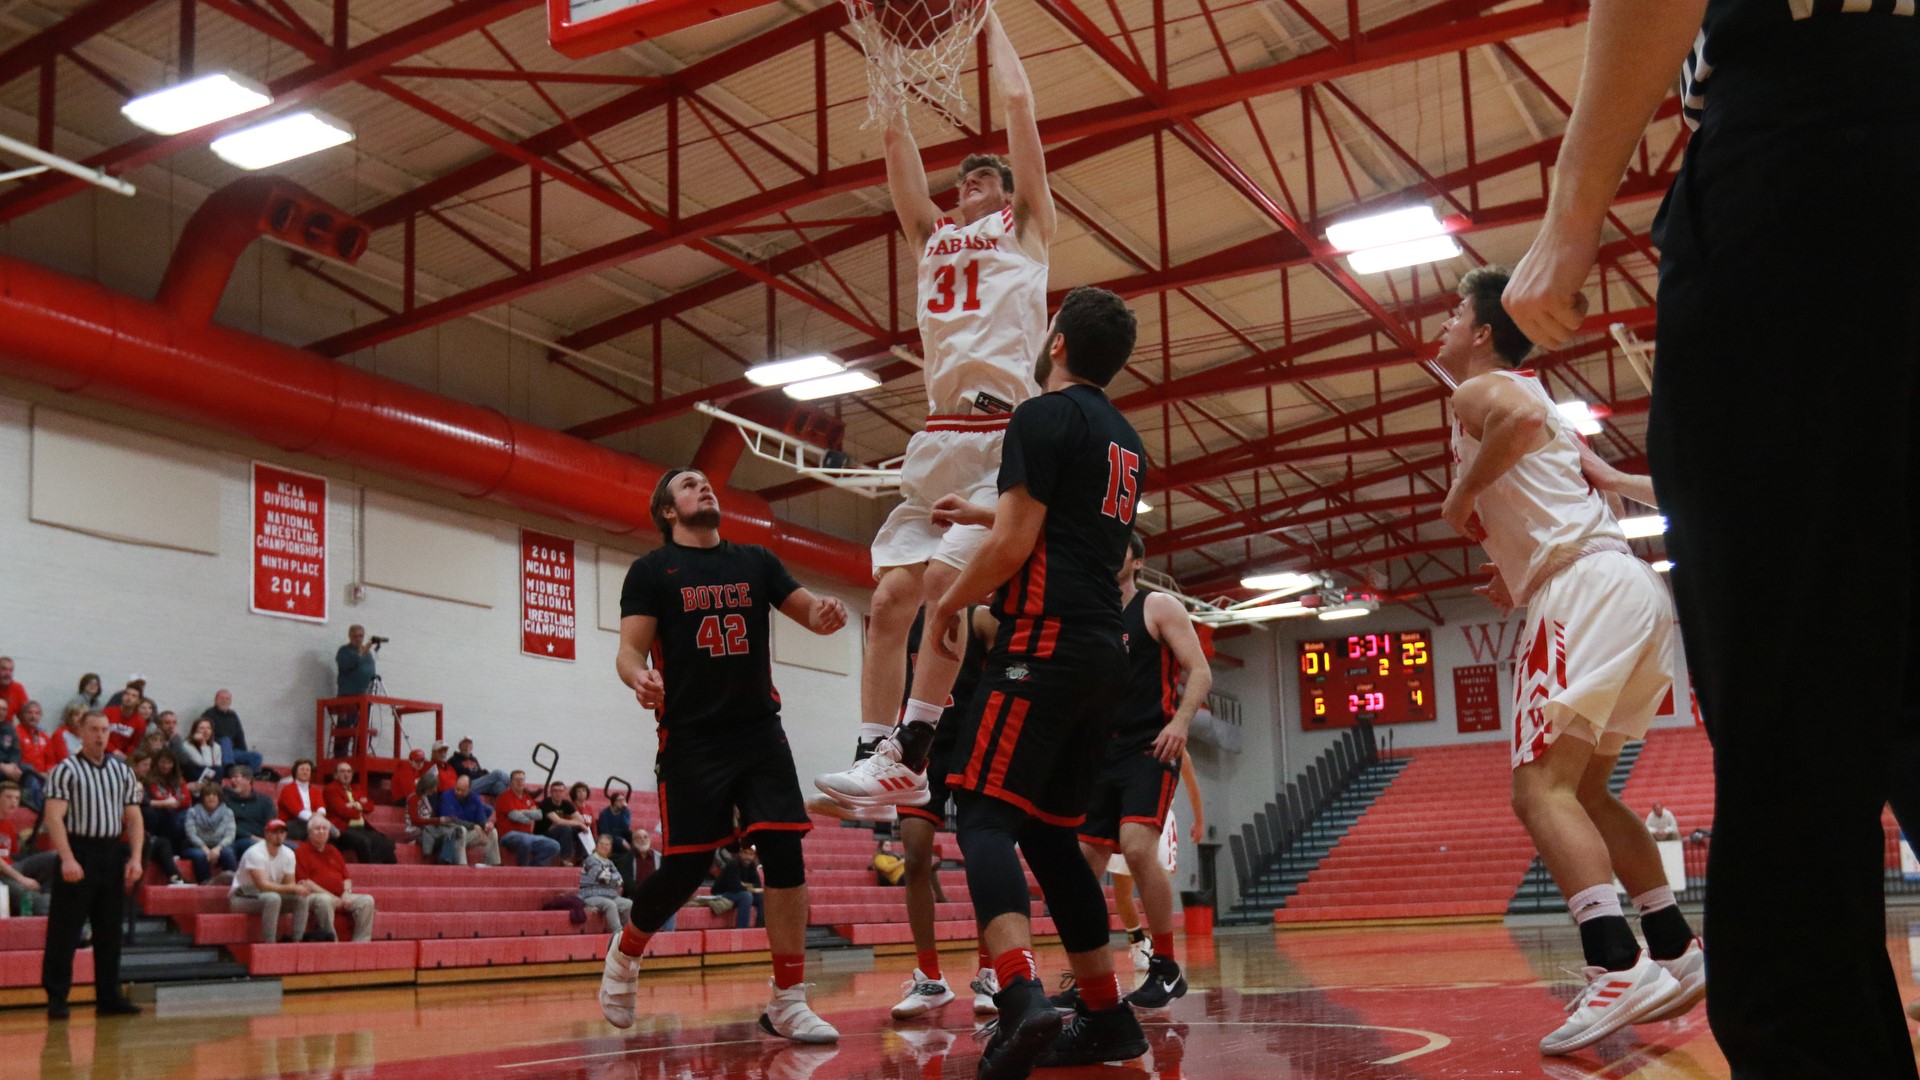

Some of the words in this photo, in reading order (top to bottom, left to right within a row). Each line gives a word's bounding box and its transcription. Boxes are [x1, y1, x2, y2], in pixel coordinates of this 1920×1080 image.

[927, 234, 1000, 258] ABASH
[927, 259, 981, 313] 31
[278, 481, 304, 498] NCAA
[1101, 441, 1139, 525] 15
[263, 490, 306, 512] DIVISION
[308, 501, 318, 514] III
[267, 510, 315, 531] NATIONAL
[264, 522, 318, 545] WRESTLING
[257, 534, 324, 559] CHAMPIONSHIPS
[261, 554, 289, 571] NINTH
[290, 559, 319, 577] PLACE
[526, 559, 551, 576] NCAA
[271, 576, 311, 598] 2014
[526, 578, 571, 598] MIDWEST
[681, 582, 752, 612] BOYCE
[696, 613, 750, 657] 42
[1348, 634, 1390, 658] 6:34
[1402, 641, 1427, 665] 25
[1378, 658, 1389, 675] 2
[1314, 698, 1326, 715] 6
[1348, 692, 1384, 712] 2-33
[1411, 690, 1423, 706] 4
